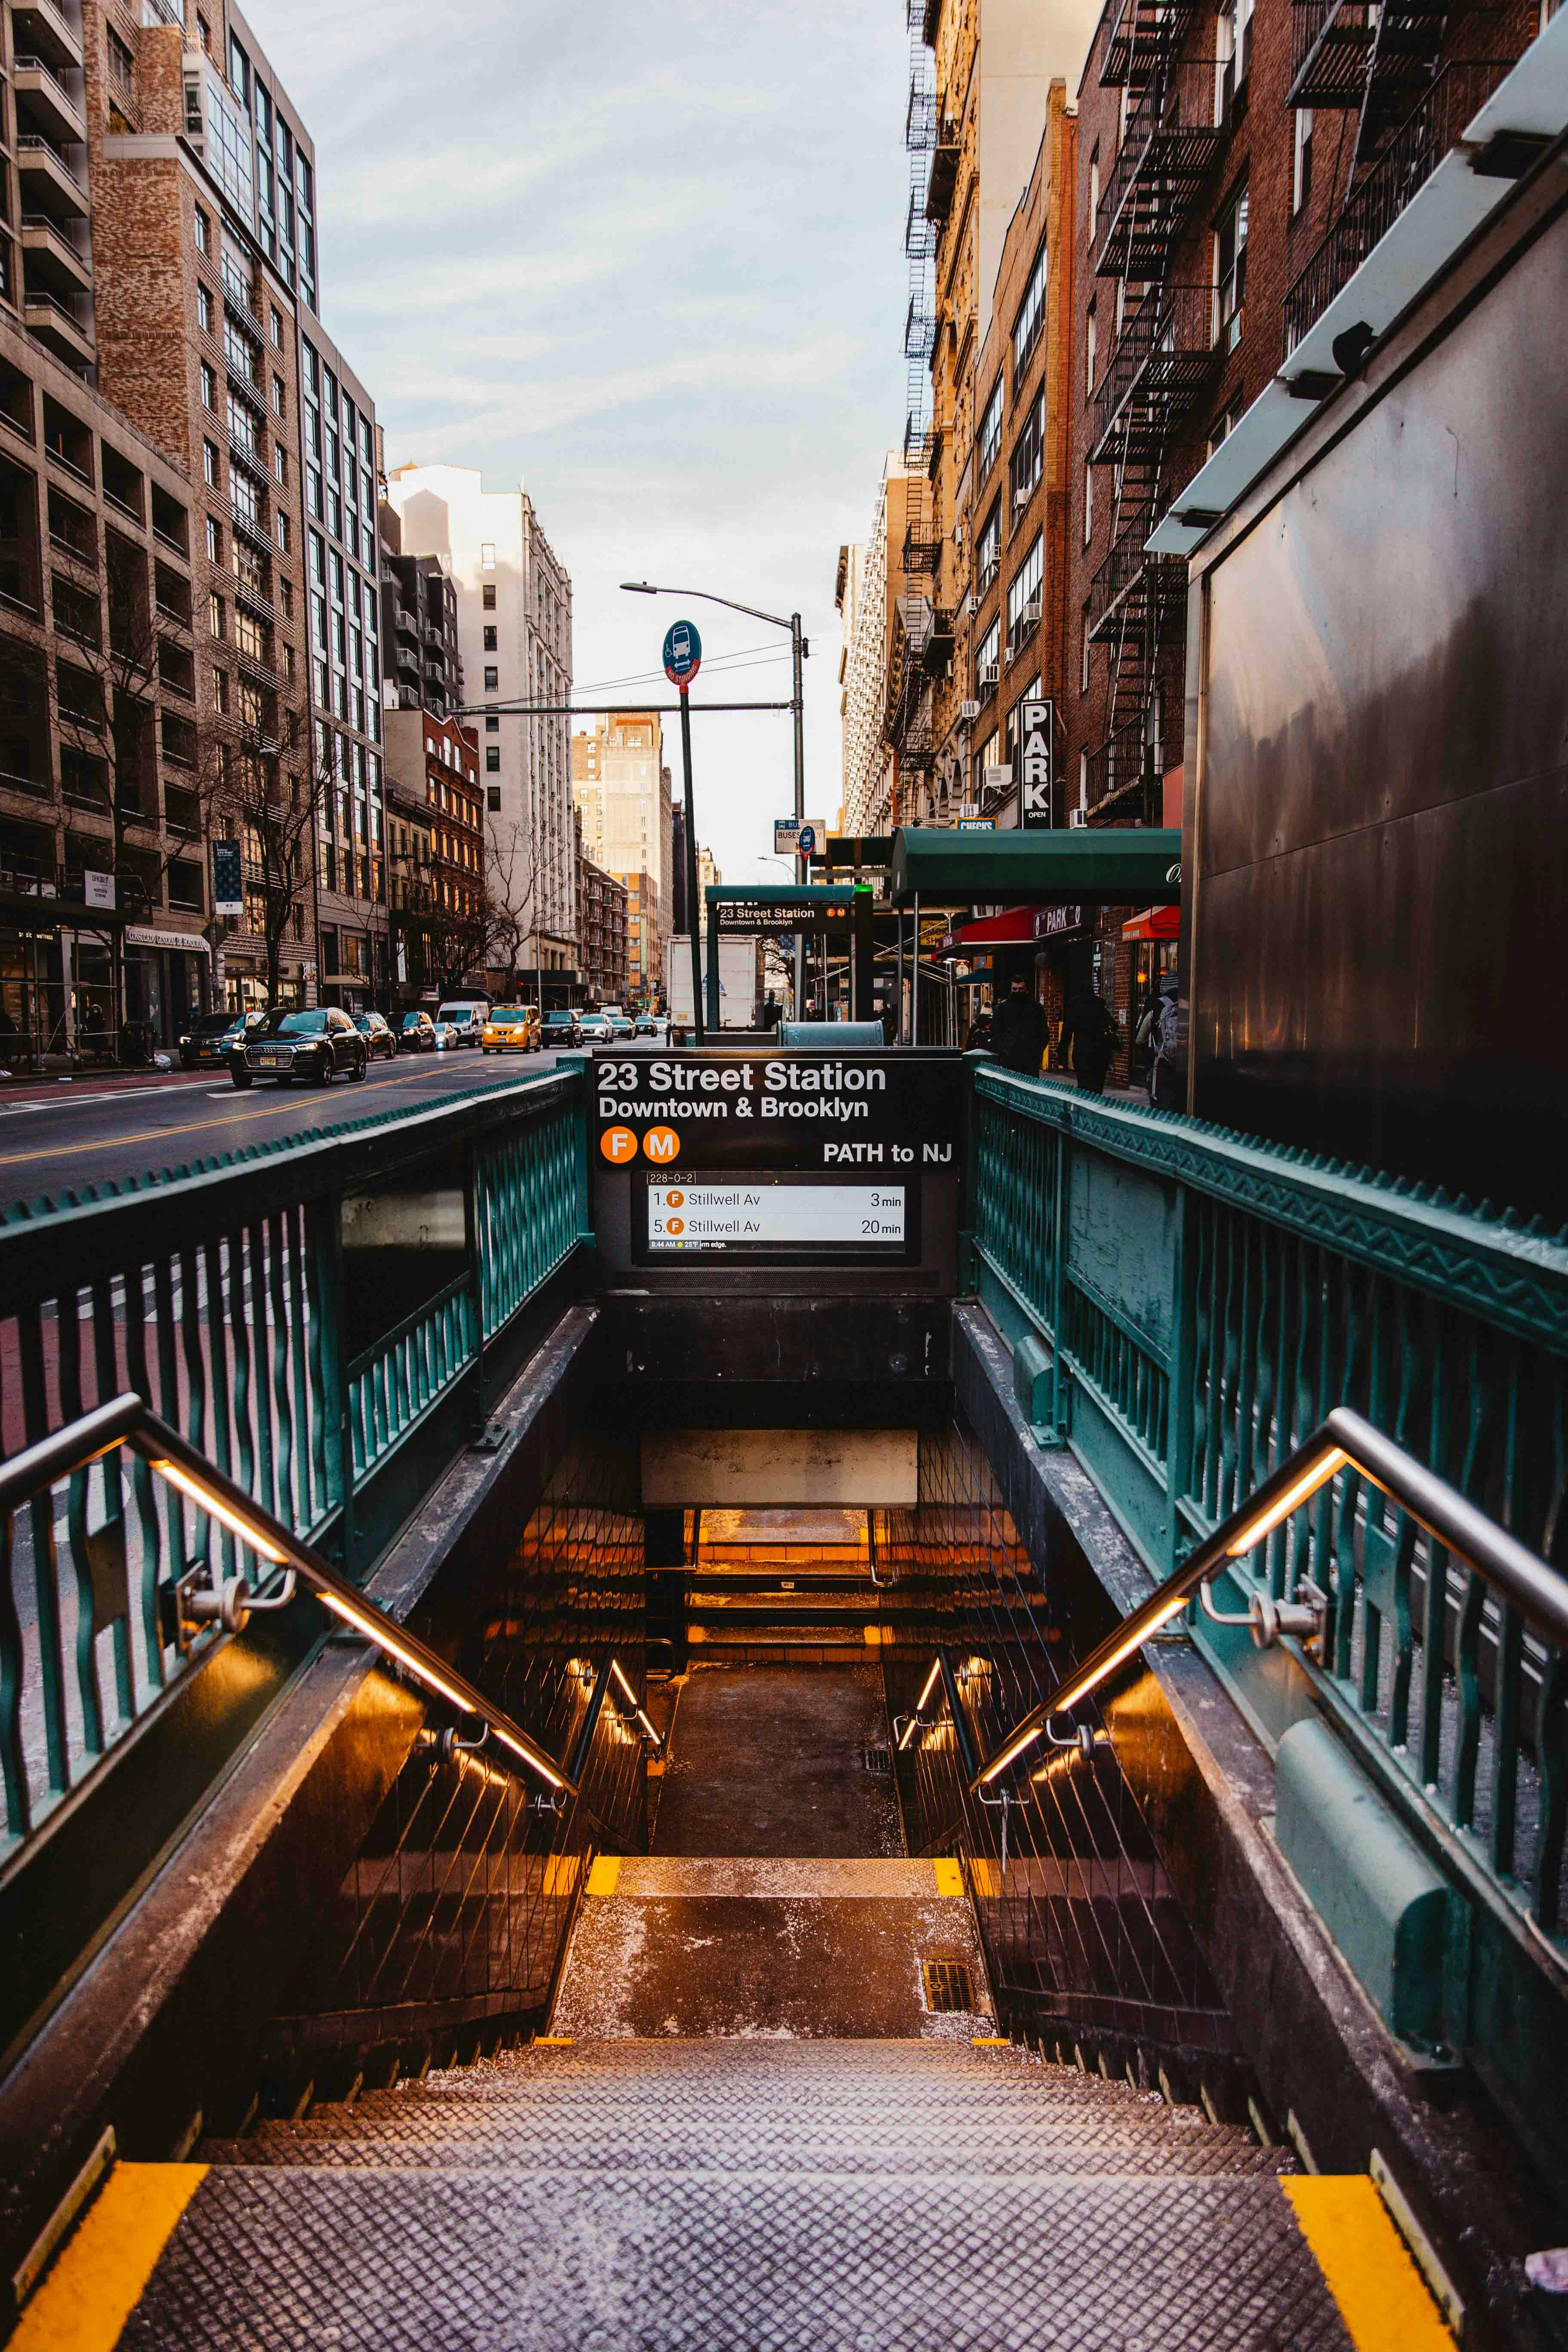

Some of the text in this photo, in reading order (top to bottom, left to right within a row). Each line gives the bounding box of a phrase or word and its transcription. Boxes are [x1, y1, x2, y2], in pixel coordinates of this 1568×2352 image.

[667, 664, 698, 683] NO STANDING
[1024, 705, 1049, 809] PARK
[720, 909, 733, 918] 23
[737, 908, 772, 918] Street
[774, 908, 815, 918] Station
[1047, 906, 1067, 932] PARK
[130, 931, 156, 942] CONSULADO
[157, 935, 177, 944] GENERAL
[177, 937, 183, 945] DE
[598, 1062, 886, 1090] 23 Street Station
[600, 1097, 868, 1121] Downtown & Brooklyn
[612, 1133, 673, 1156] F M
[824, 1143, 952, 1162] PATH to NJ
[650, 1174, 692, 1182] 228-0-2
[654, 1192, 665, 1206] 1.
[689, 1193, 739, 1205] Stillwell
[744, 1193, 760, 1205] Av
[871, 1193, 879, 1207] 3
[882, 1197, 901, 1207] min
[654, 1219, 665, 1232] 5.
[689, 1220, 739, 1232] Stillwell
[744, 1221, 760, 1232] Av
[862, 1220, 879, 1233] 20
[882, 1224, 900, 1233] min
